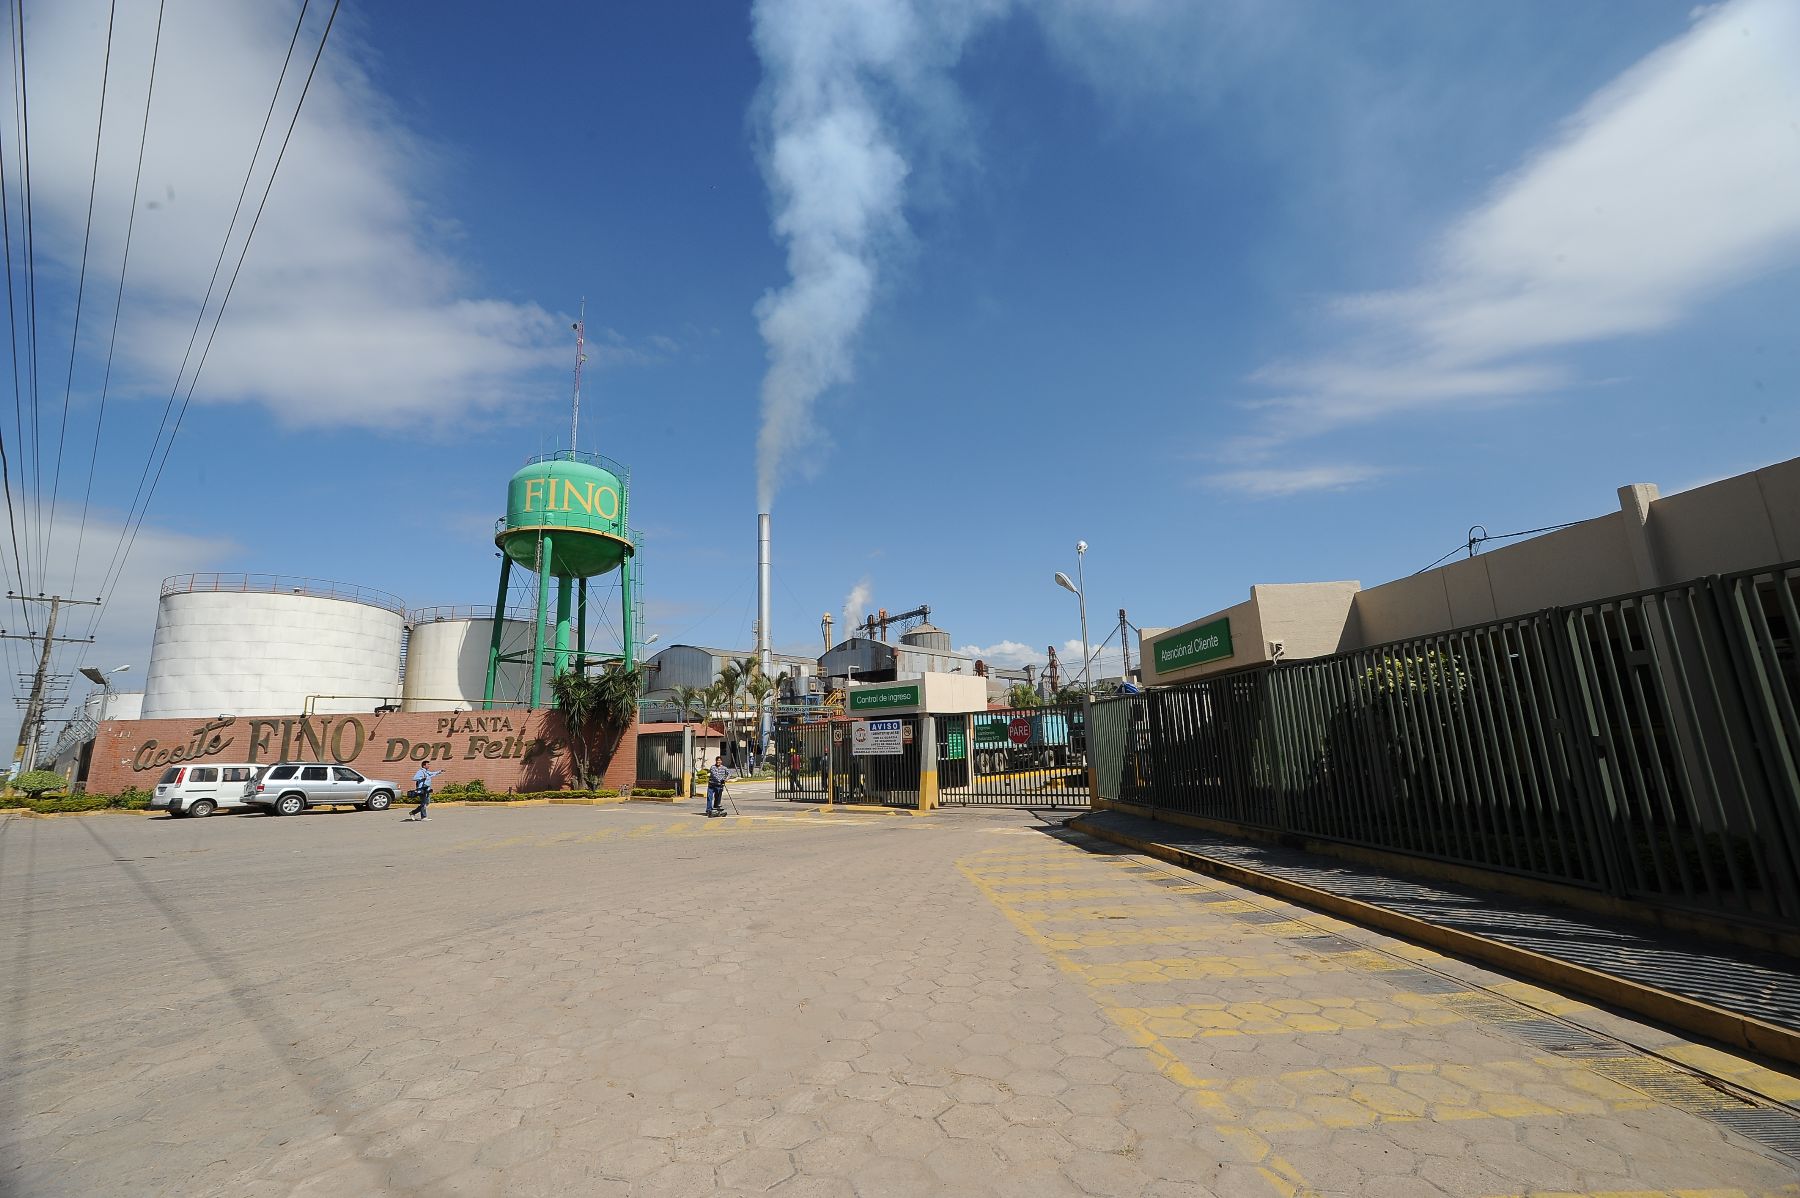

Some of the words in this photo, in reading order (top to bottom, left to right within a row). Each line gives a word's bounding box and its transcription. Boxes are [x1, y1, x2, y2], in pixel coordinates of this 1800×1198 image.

[523, 477, 619, 520] FINO
[1161, 643, 1188, 662] Atención
[1194, 634, 1219, 652] Cliente
[856, 695, 879, 704] Control
[879, 694, 887, 702] de
[888, 693, 911, 703] ingreso
[437, 716, 513, 734] PLANTA
[871, 722, 898, 731] AVISO
[1009, 725, 1029, 737] PARE
[247, 716, 366, 765] FINO
[383, 737, 453, 762] Don
[464, 735, 565, 765] Felipe
